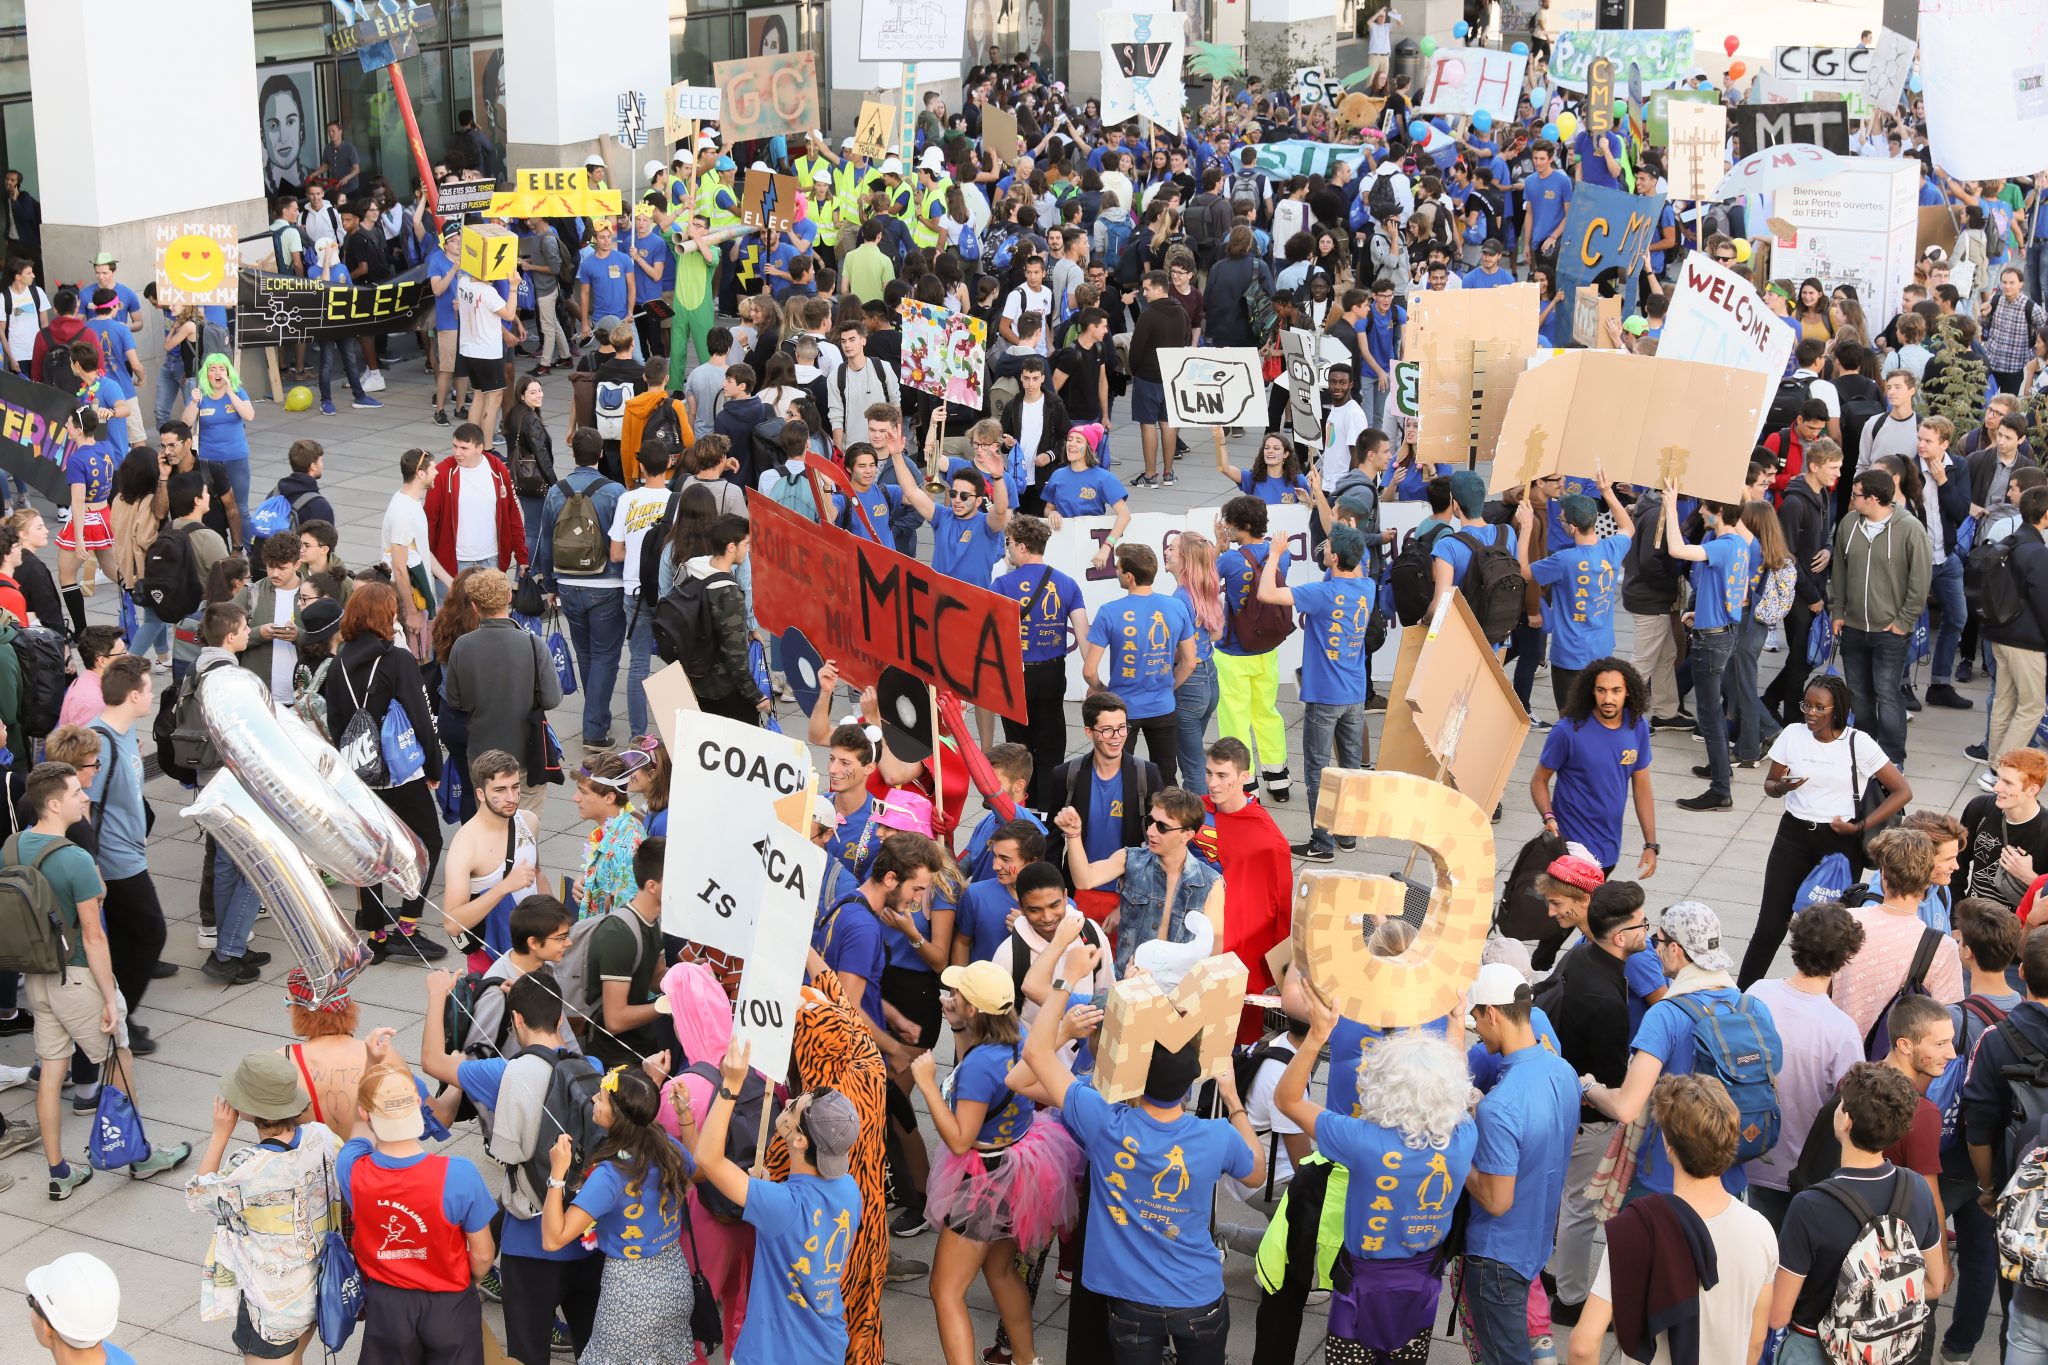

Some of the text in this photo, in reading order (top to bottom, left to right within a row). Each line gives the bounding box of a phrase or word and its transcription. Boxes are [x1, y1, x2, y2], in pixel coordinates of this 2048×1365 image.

[375, 10, 419, 37] ELEC
[1123, 44, 1165, 76] SV
[1779, 46, 1870, 77] CGC
[679, 93, 720, 111] ELEC
[726, 66, 805, 126] GC
[1590, 60, 1609, 131] CMS
[1755, 111, 1843, 153] MT
[1743, 147, 1824, 176] CMS
[529, 172, 577, 191] ELEC
[1793, 186, 1842, 198] Bienvenue
[1792, 208, 1804, 217] de
[1811, 198, 1841, 208] Portes
[1843, 202, 1884, 210] ouvertes
[209, 224, 232, 239] MX
[744, 210, 789, 230] ELEC
[266, 278, 325, 291] COACHING
[327, 281, 415, 320] ELEC
[1688, 263, 1771, 352] WELCOME
[1180, 389, 1225, 415] LAN
[1573, 560, 1591, 623] COACH
[857, 545, 1014, 710] MECA
[1327, 594, 1346, 662] COACH
[1122, 610, 1137, 679] COACH
[697, 877, 737, 918] IS
[737, 999, 783, 1029] YOU
[311, 1068, 361, 1084] WITZ
[1144, 1199, 1162, 1209] YOUR
[1361, 1151, 1403, 1251] COACH
[621, 1181, 645, 1260] COAC
[1140, 1210, 1173, 1225] EPFL
[1407, 1225, 1438, 1235] EPFL
